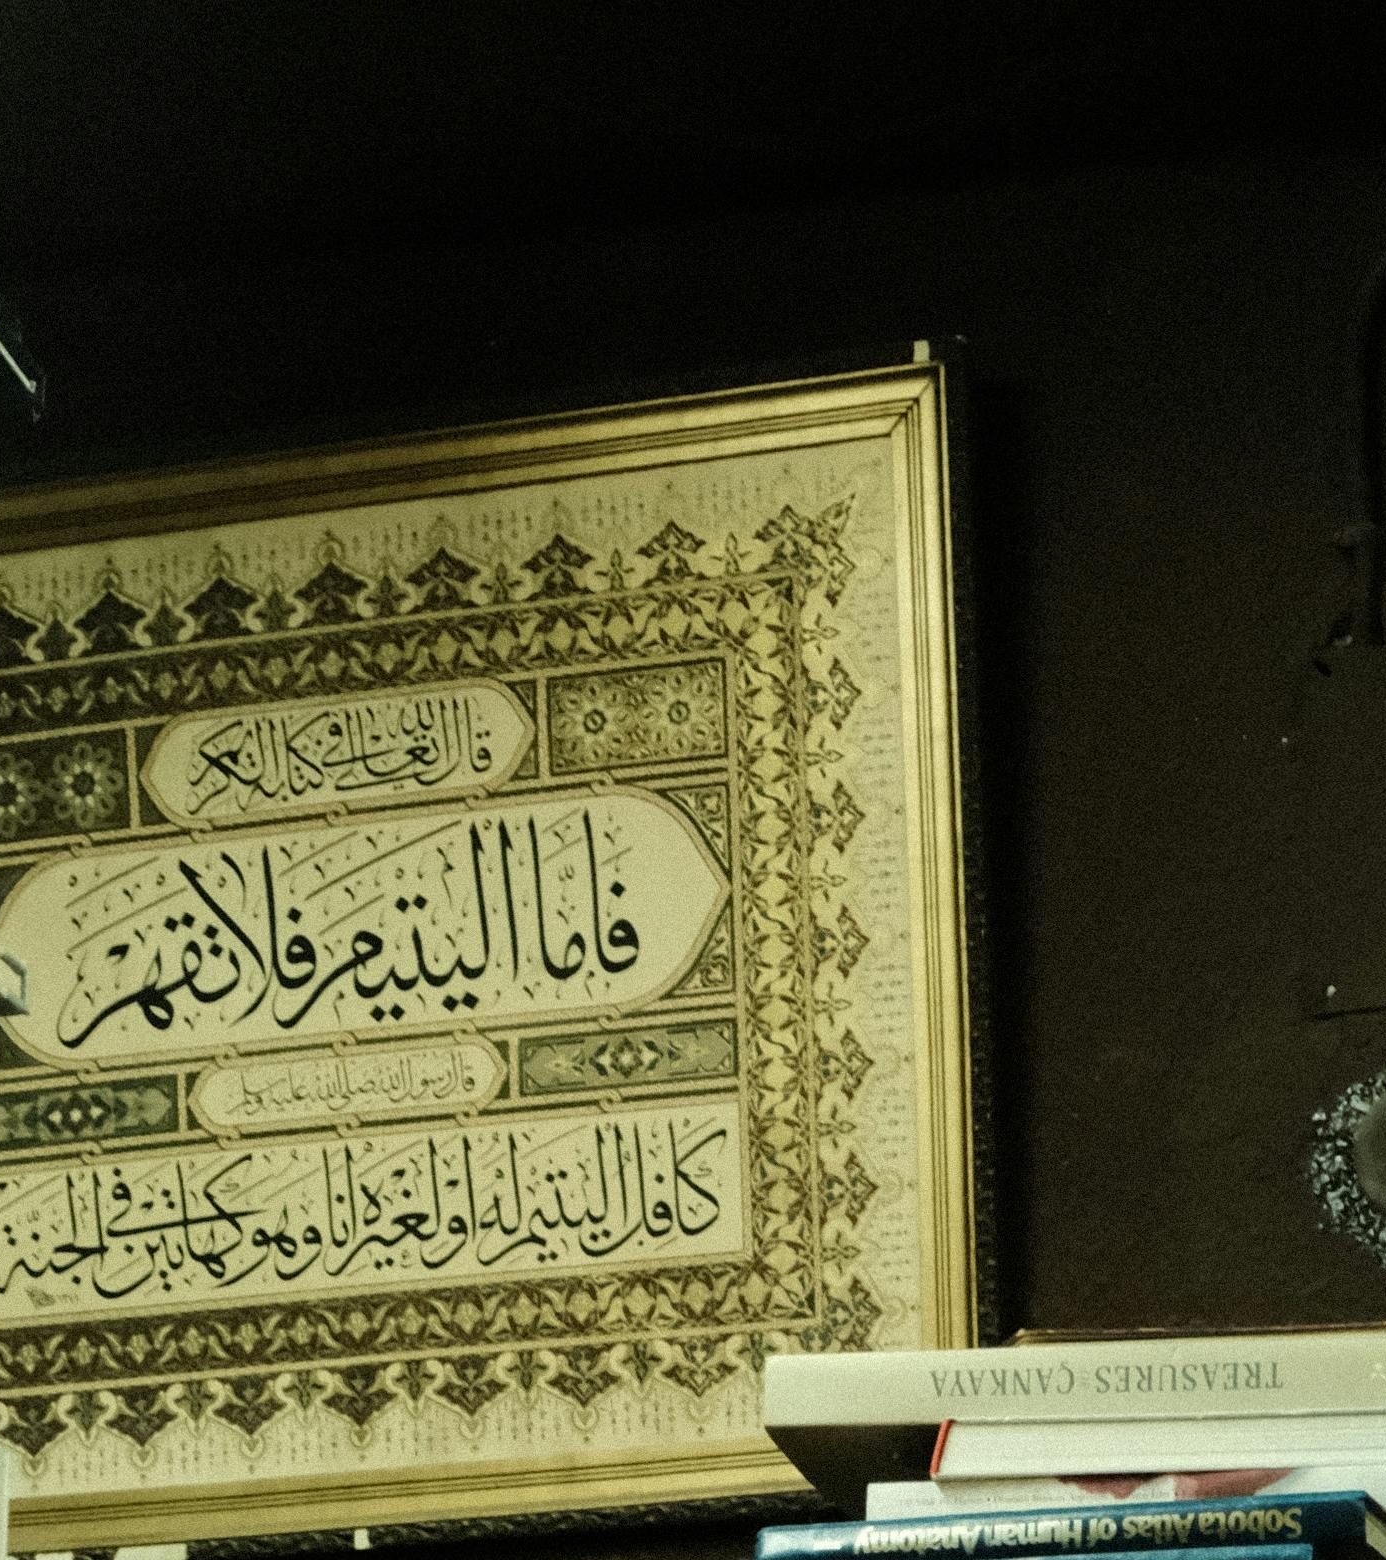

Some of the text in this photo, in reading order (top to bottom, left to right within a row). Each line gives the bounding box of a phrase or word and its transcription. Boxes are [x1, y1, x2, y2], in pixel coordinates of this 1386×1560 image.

[1094, 1361, 1284, 1394] TREASURES
[851, 1508, 1303, 1559] Sobota Atlas of Human Anatomy
